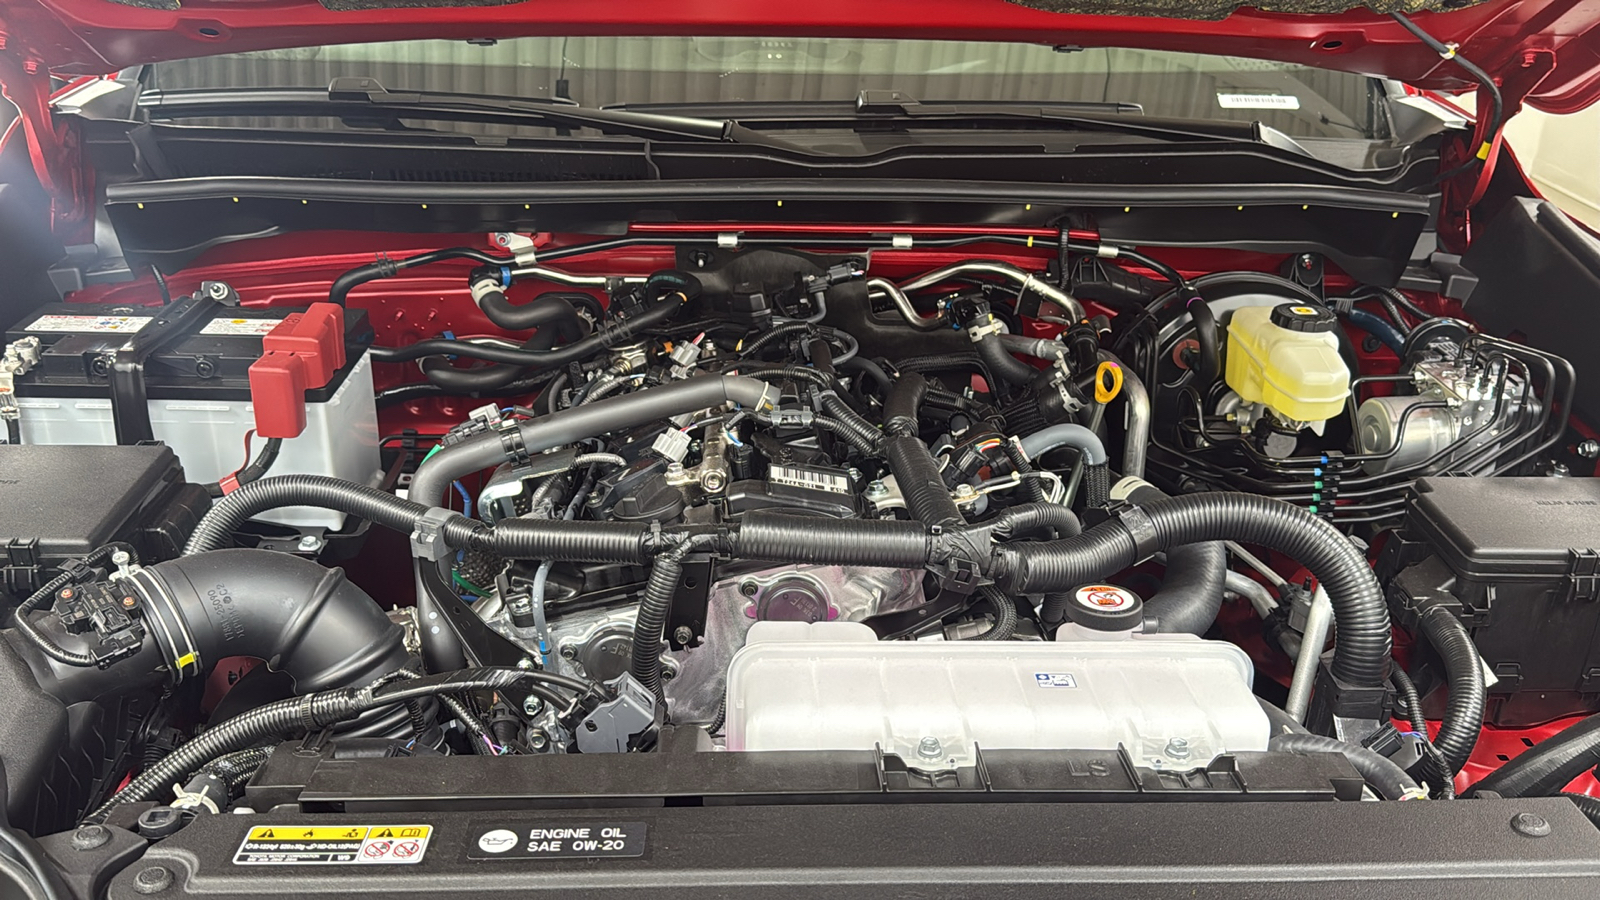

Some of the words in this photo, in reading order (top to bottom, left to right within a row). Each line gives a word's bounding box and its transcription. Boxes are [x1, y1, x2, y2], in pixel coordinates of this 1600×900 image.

[1066, 759, 1111, 777] LS
[529, 828, 591, 840] ENGINE
[600, 827, 627, 838] OIL
[527, 840, 562, 852] SAE
[572, 840, 625, 851] 0W-20
